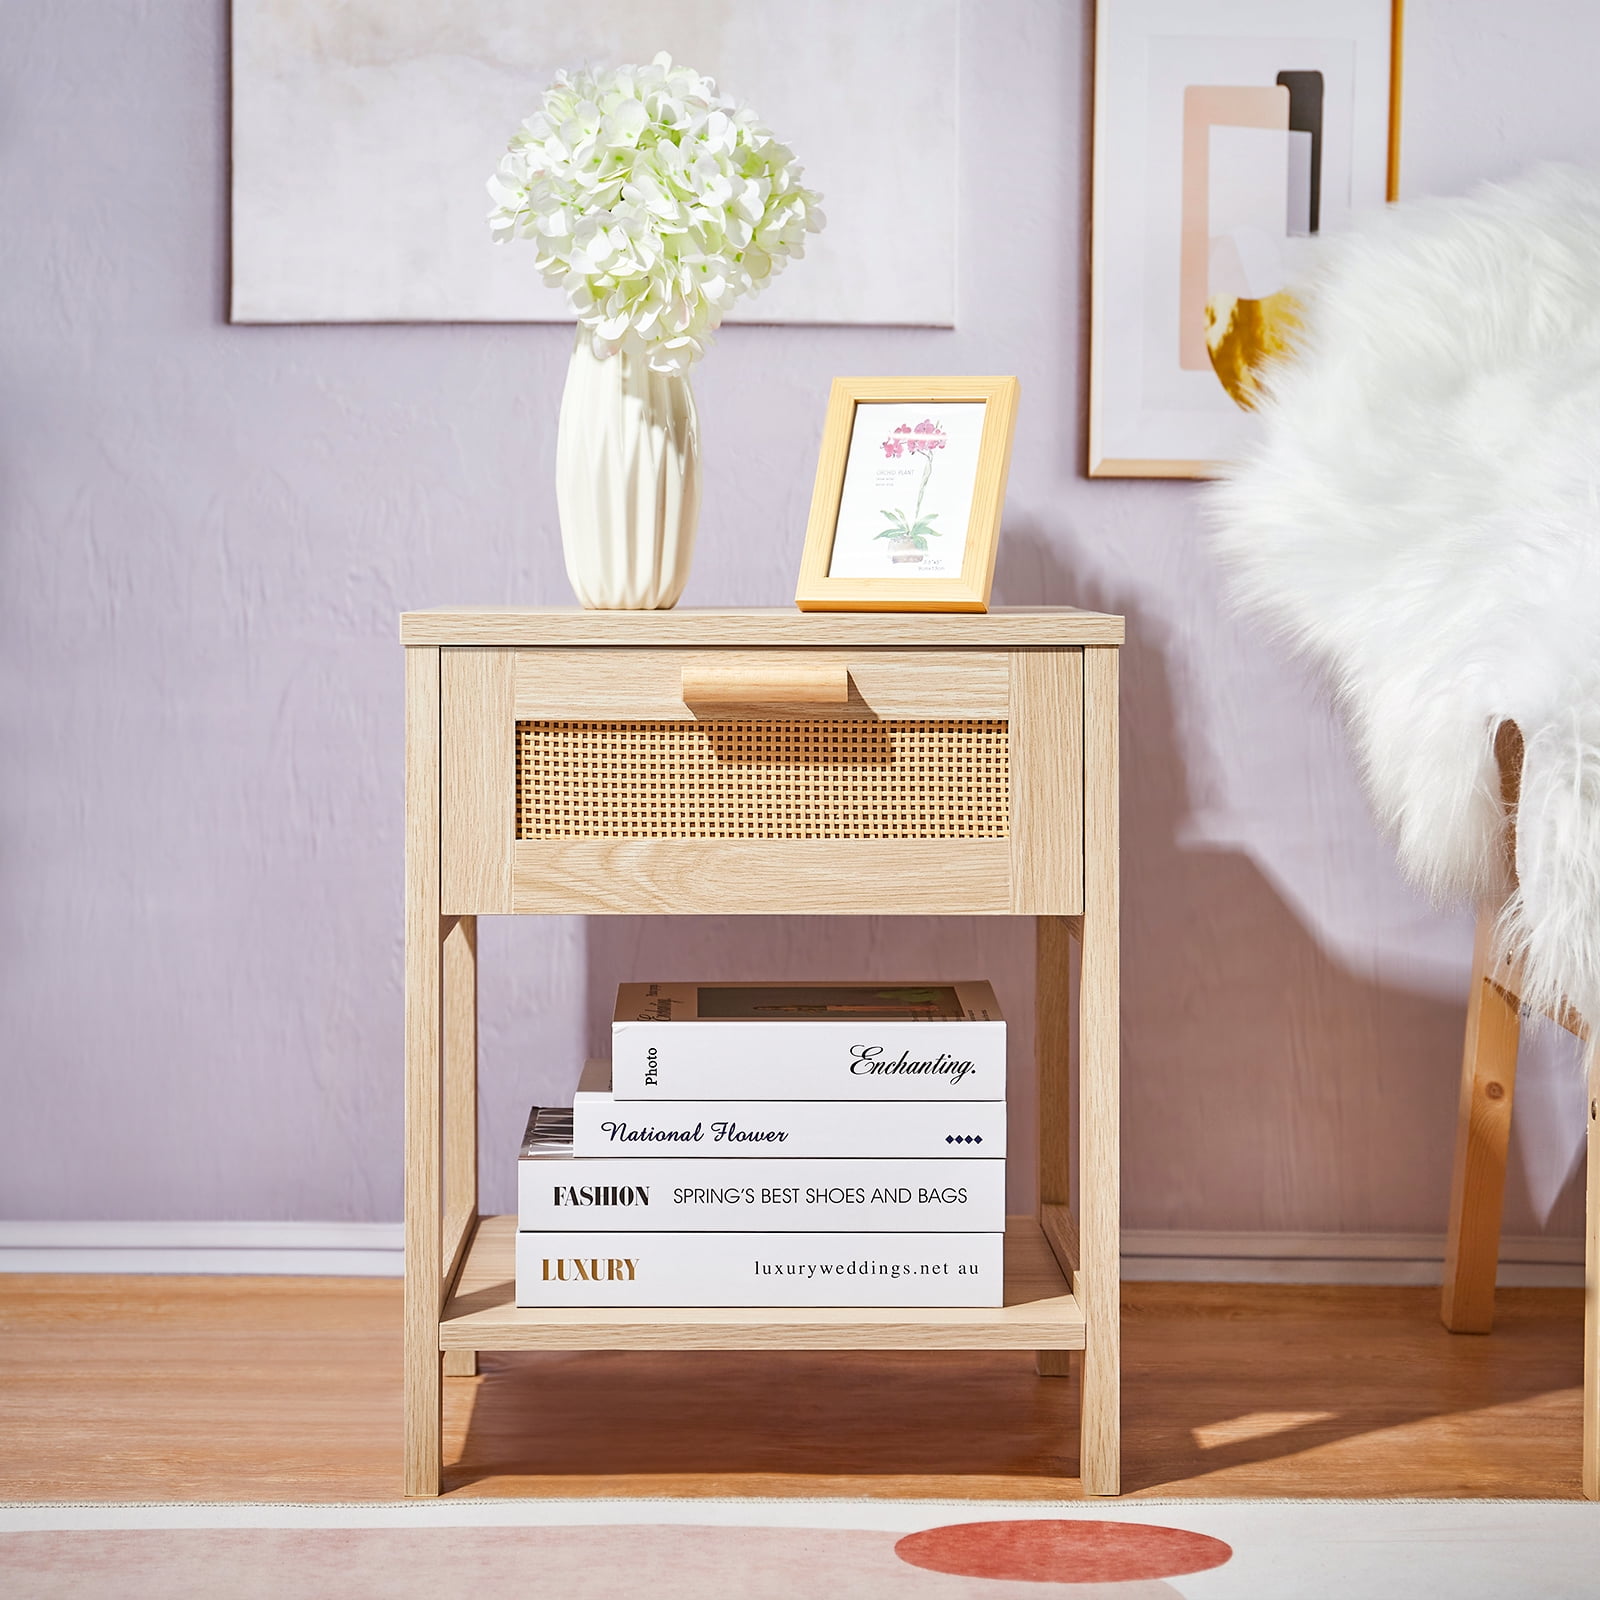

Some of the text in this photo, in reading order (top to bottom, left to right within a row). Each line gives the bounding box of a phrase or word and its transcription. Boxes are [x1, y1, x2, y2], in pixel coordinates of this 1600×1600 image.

[645, 1047, 658, 1086] Photo
[849, 1044, 976, 1085] Enchanting.
[600, 1121, 789, 1143] National Flower
[553, 1186, 650, 1206] FASHION
[673, 1187, 968, 1204] SPRING'S BEST SHOES AND BAGS
[542, 1258, 640, 1281] LUXURY
[754, 1260, 979, 1279] luxuryweddings.net au
